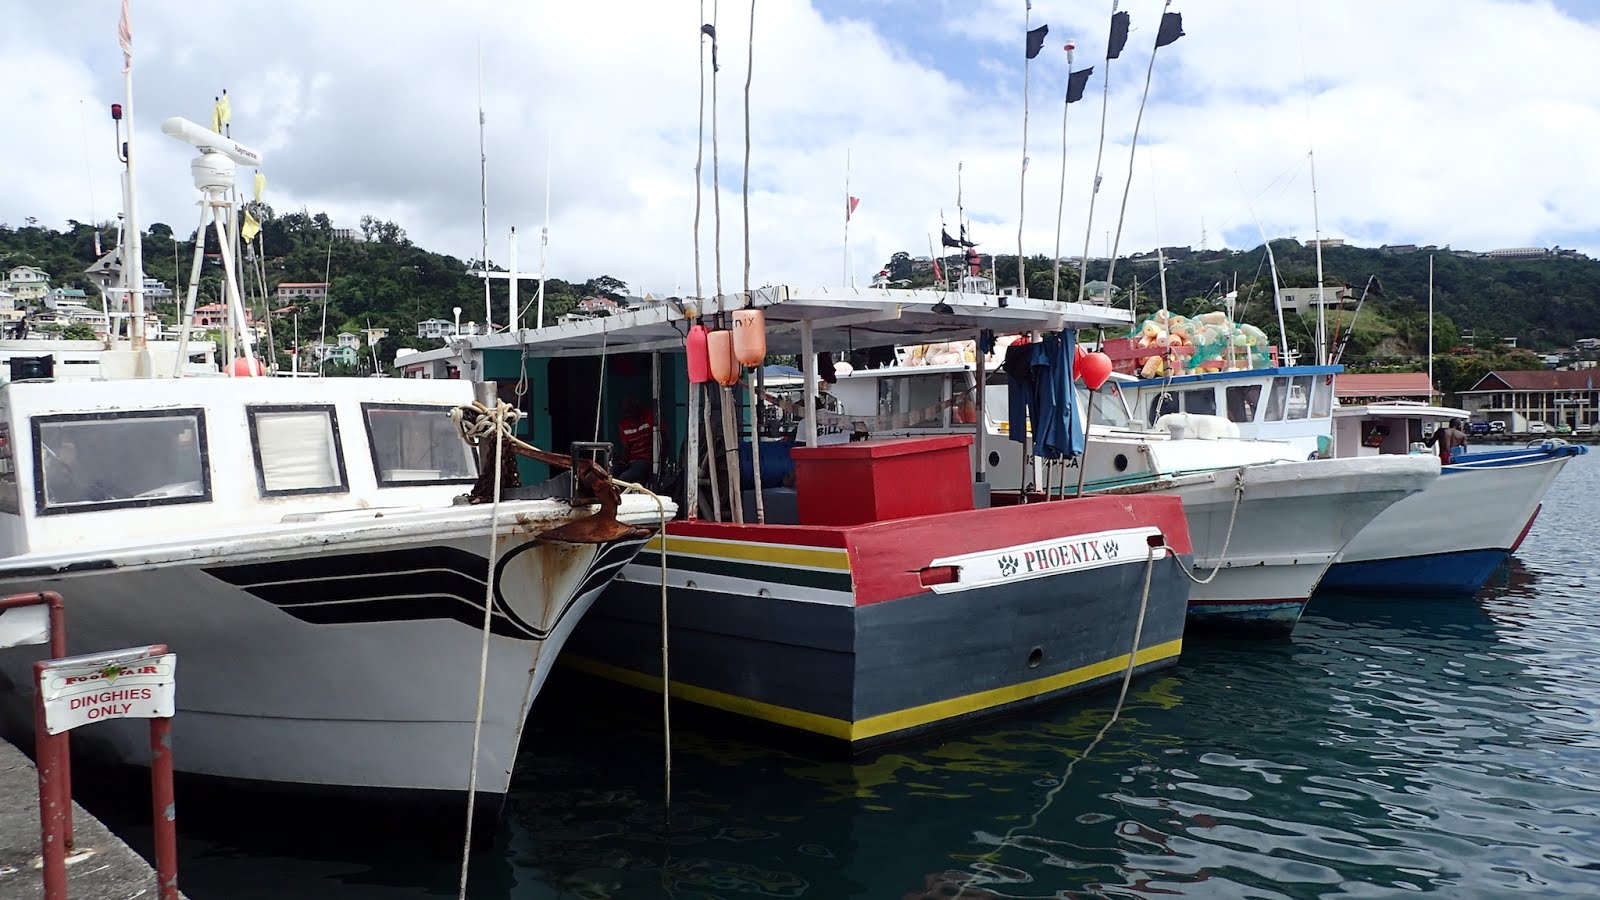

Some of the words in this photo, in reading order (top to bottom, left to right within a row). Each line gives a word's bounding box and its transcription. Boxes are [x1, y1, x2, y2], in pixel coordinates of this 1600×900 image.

[1024, 541, 1102, 572] PHOENIX
[70, 688, 152, 710] DINGHIES
[87, 703, 132, 719] ONLY
